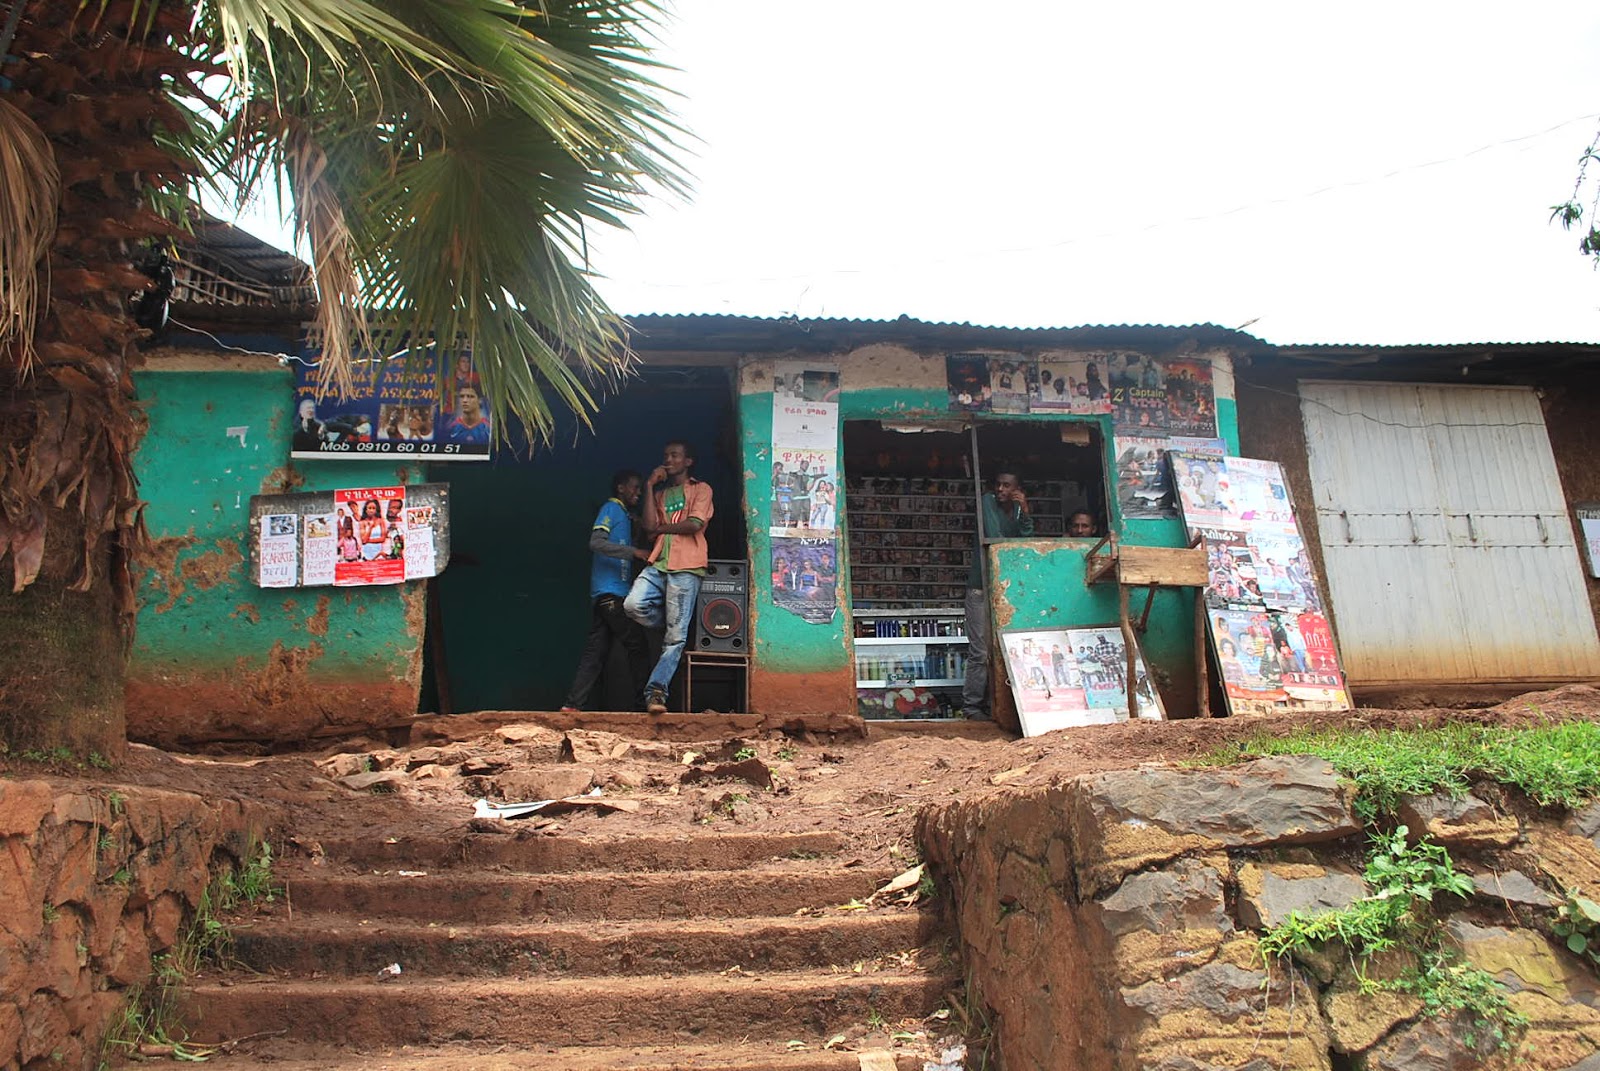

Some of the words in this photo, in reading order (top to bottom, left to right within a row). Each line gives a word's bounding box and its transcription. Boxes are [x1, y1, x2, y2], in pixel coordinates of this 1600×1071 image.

[1128, 386, 1165, 399] Captain
[319, 441, 350, 452] Mob
[356, 442, 391, 452] 0910
[396, 442, 415, 453] 60
[420, 442, 437, 453] 01
[443, 443, 461, 453] 51
